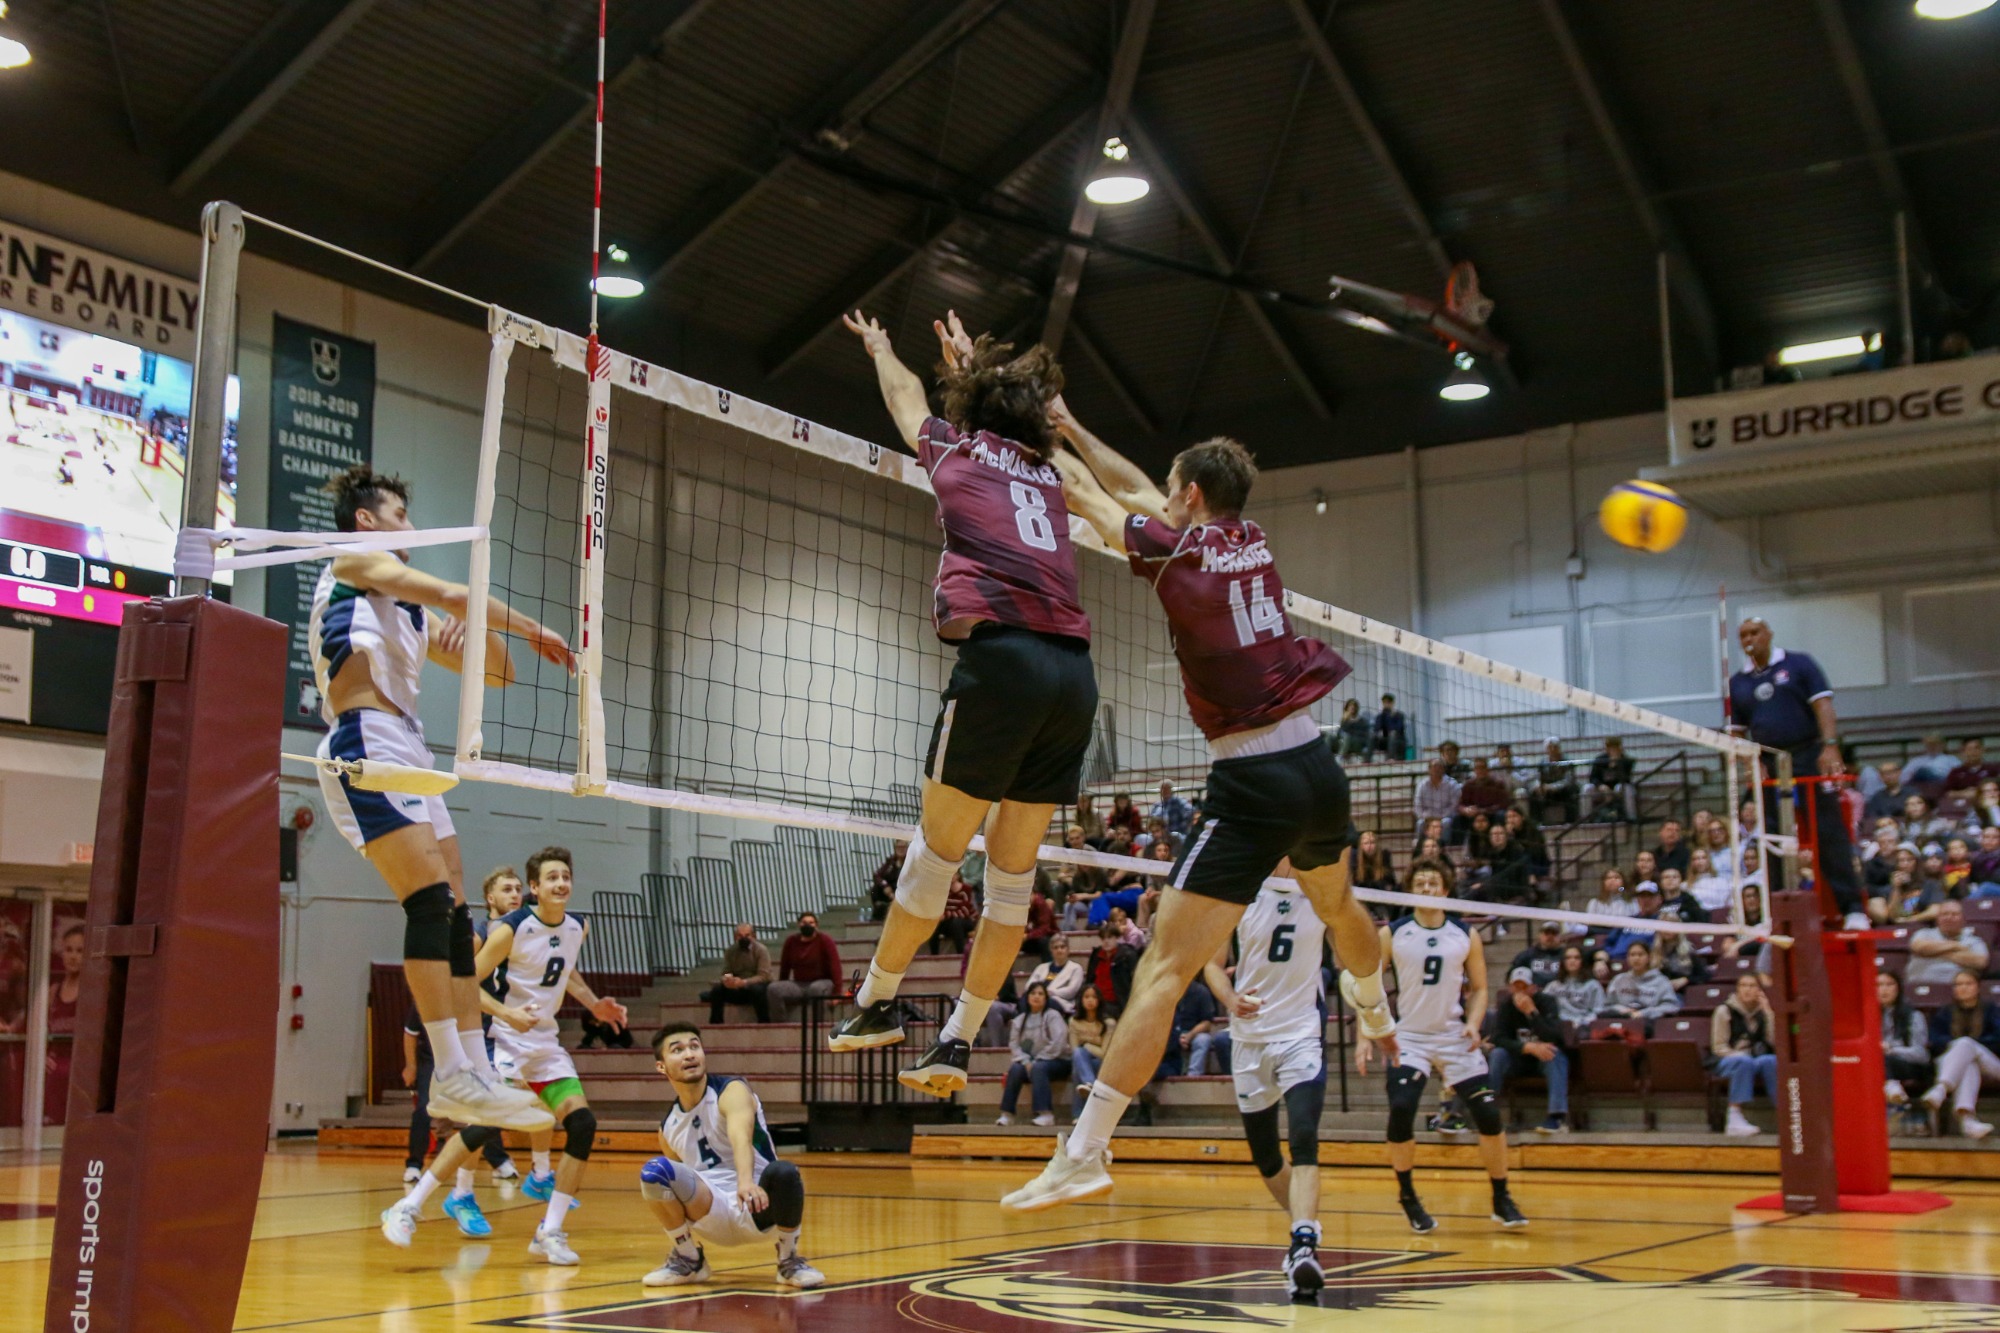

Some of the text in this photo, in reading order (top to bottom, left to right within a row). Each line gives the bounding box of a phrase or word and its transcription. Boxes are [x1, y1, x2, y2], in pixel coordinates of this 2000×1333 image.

[293, 409, 354, 440] WOMEN'S
[1732, 385, 1963, 443] BURRIDGE
[278, 429, 364, 465] BASKETBALL
[1009, 480, 1058, 552] 8
[1228, 574, 1285, 648] 14
[1268, 924, 1296, 962] 6
[540, 956, 565, 987] 8
[1422, 955, 1443, 985] 9
[698, 1136, 723, 1169] 5
[79, 1159, 104, 1264] sports
